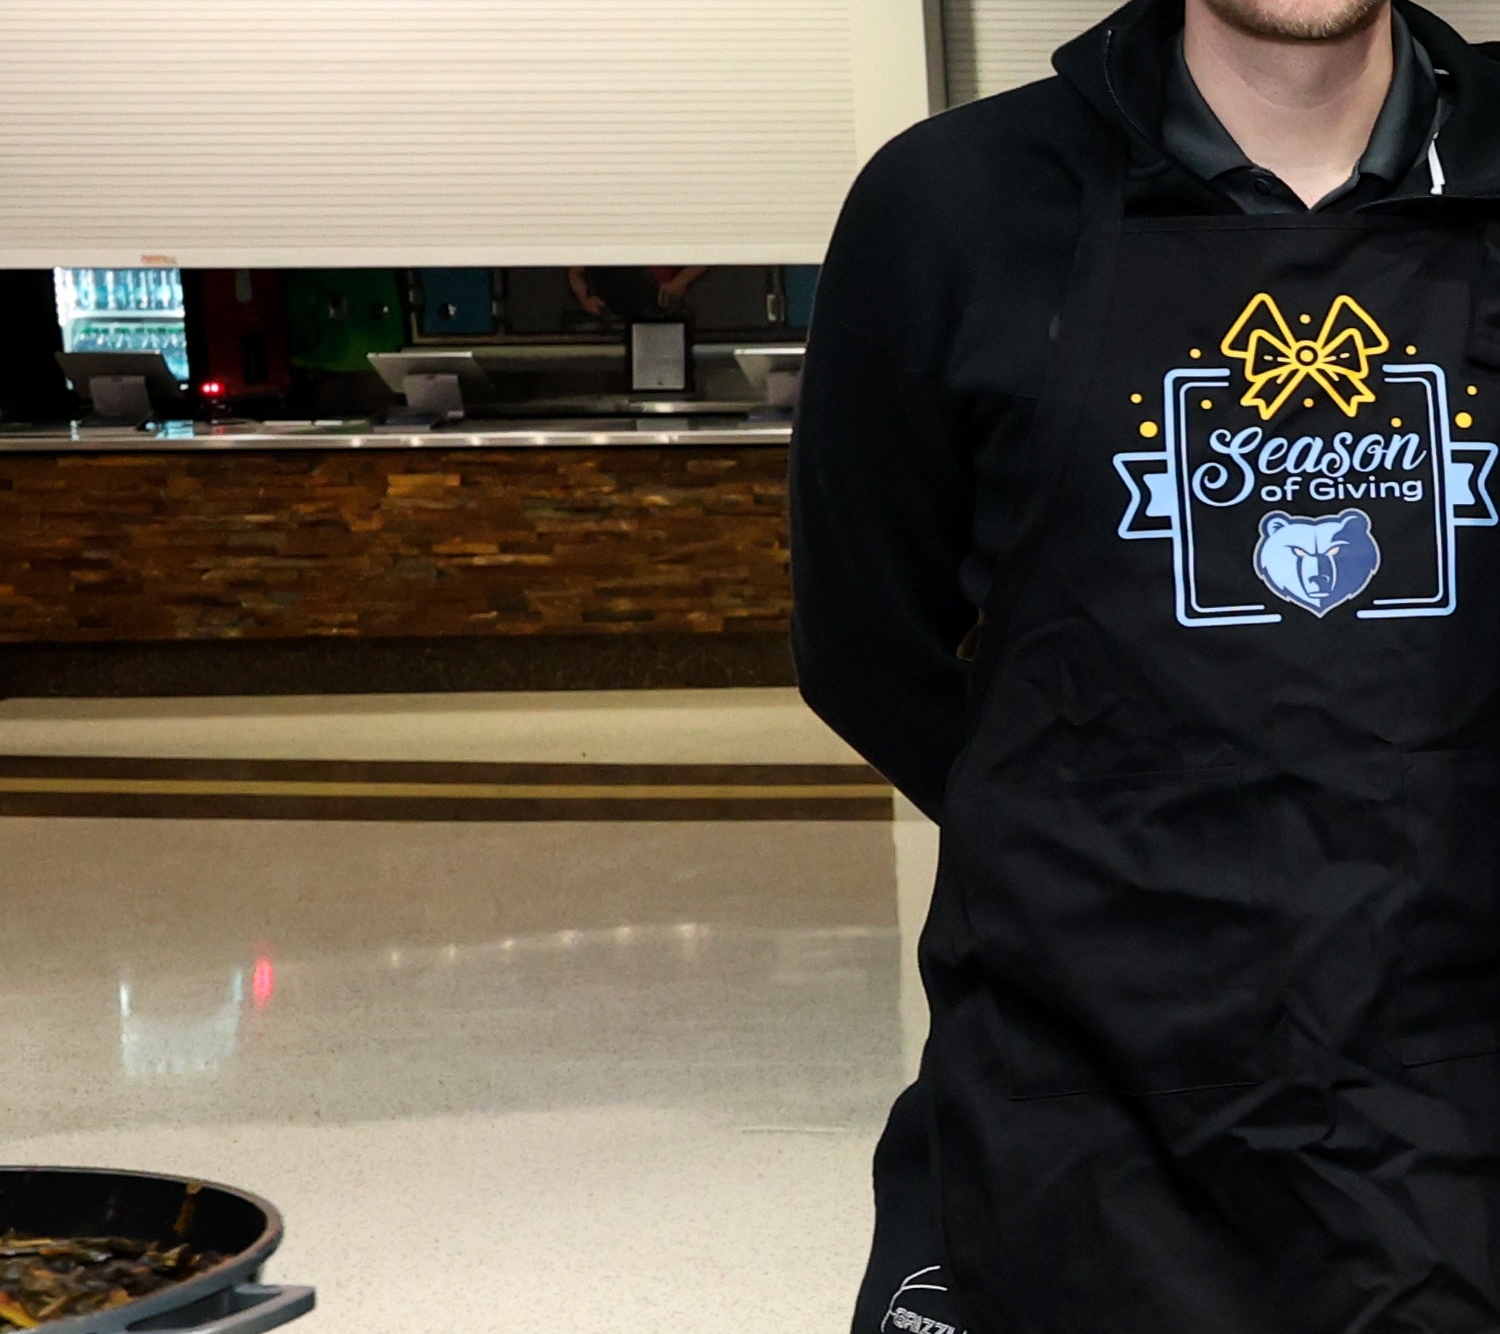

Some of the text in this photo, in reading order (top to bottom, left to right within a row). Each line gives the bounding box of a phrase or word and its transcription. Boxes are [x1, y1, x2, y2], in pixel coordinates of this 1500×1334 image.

[1191, 426, 1427, 507] Season
[1260, 476, 1423, 503] of Giving
